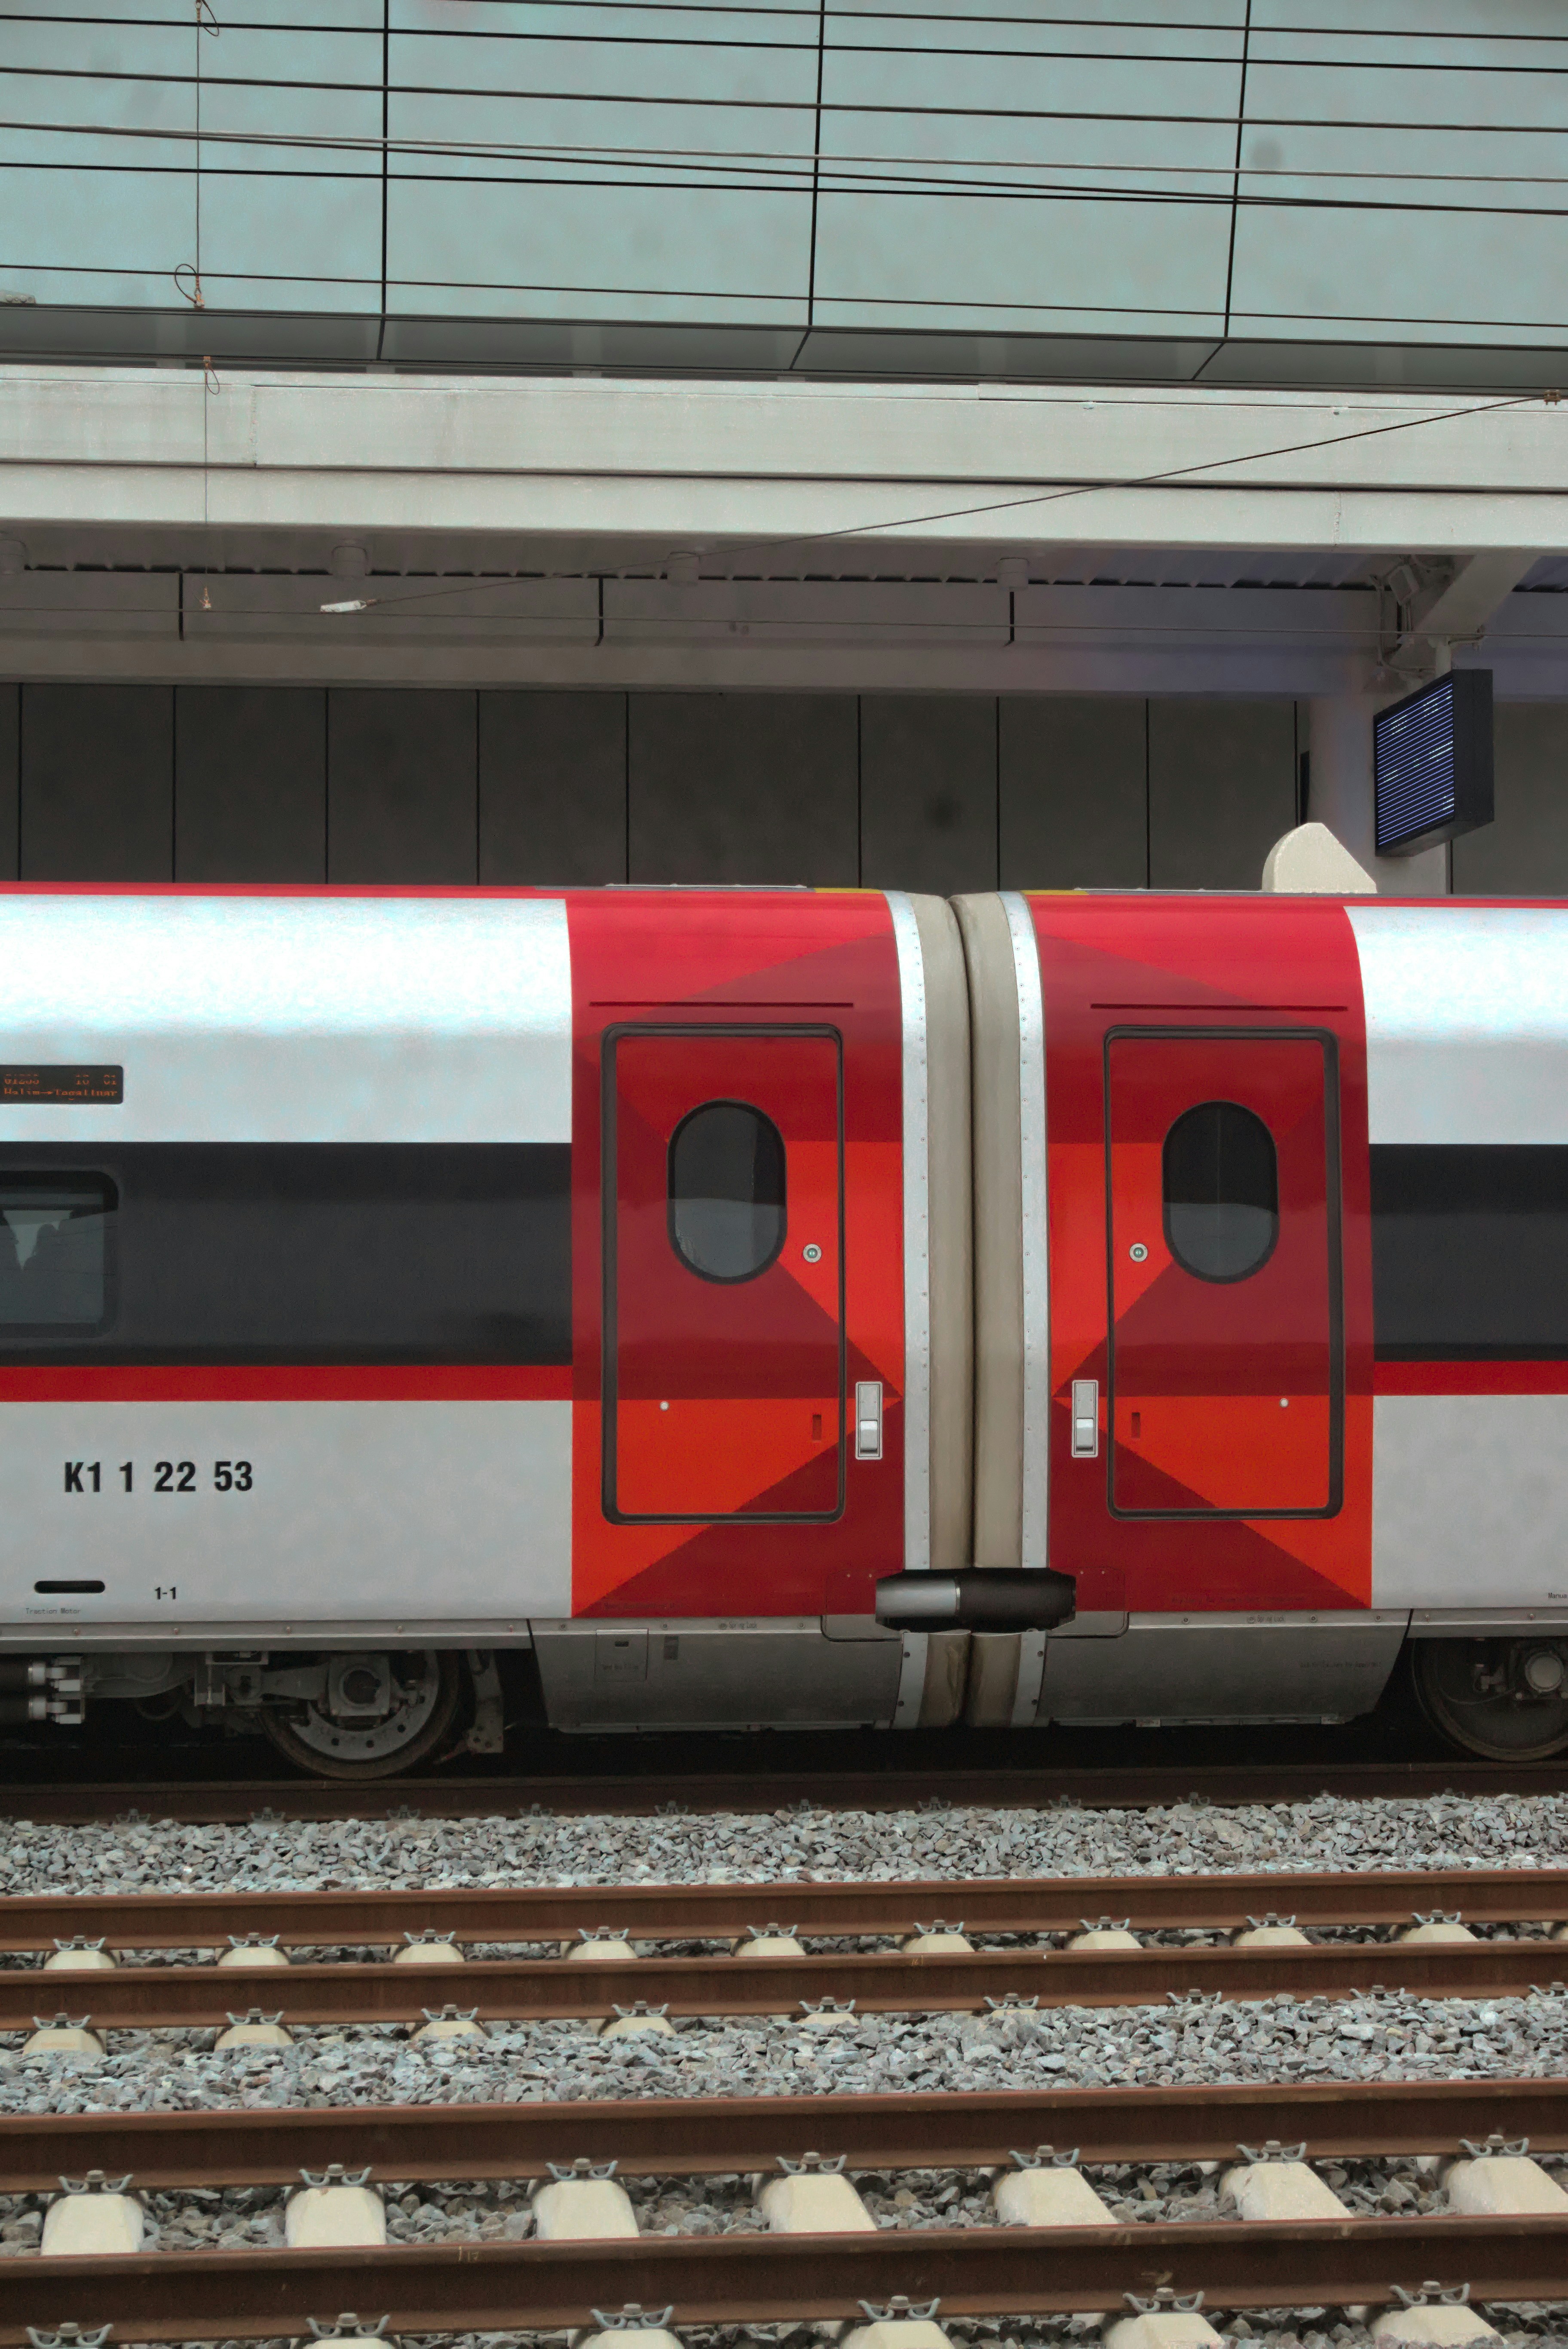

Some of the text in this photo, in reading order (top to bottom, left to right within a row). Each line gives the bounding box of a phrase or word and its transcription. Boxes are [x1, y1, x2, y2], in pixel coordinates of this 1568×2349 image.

[64, 1461, 253, 1493] K1 1 22 53
[154, 1586, 177, 1600] 1-1
